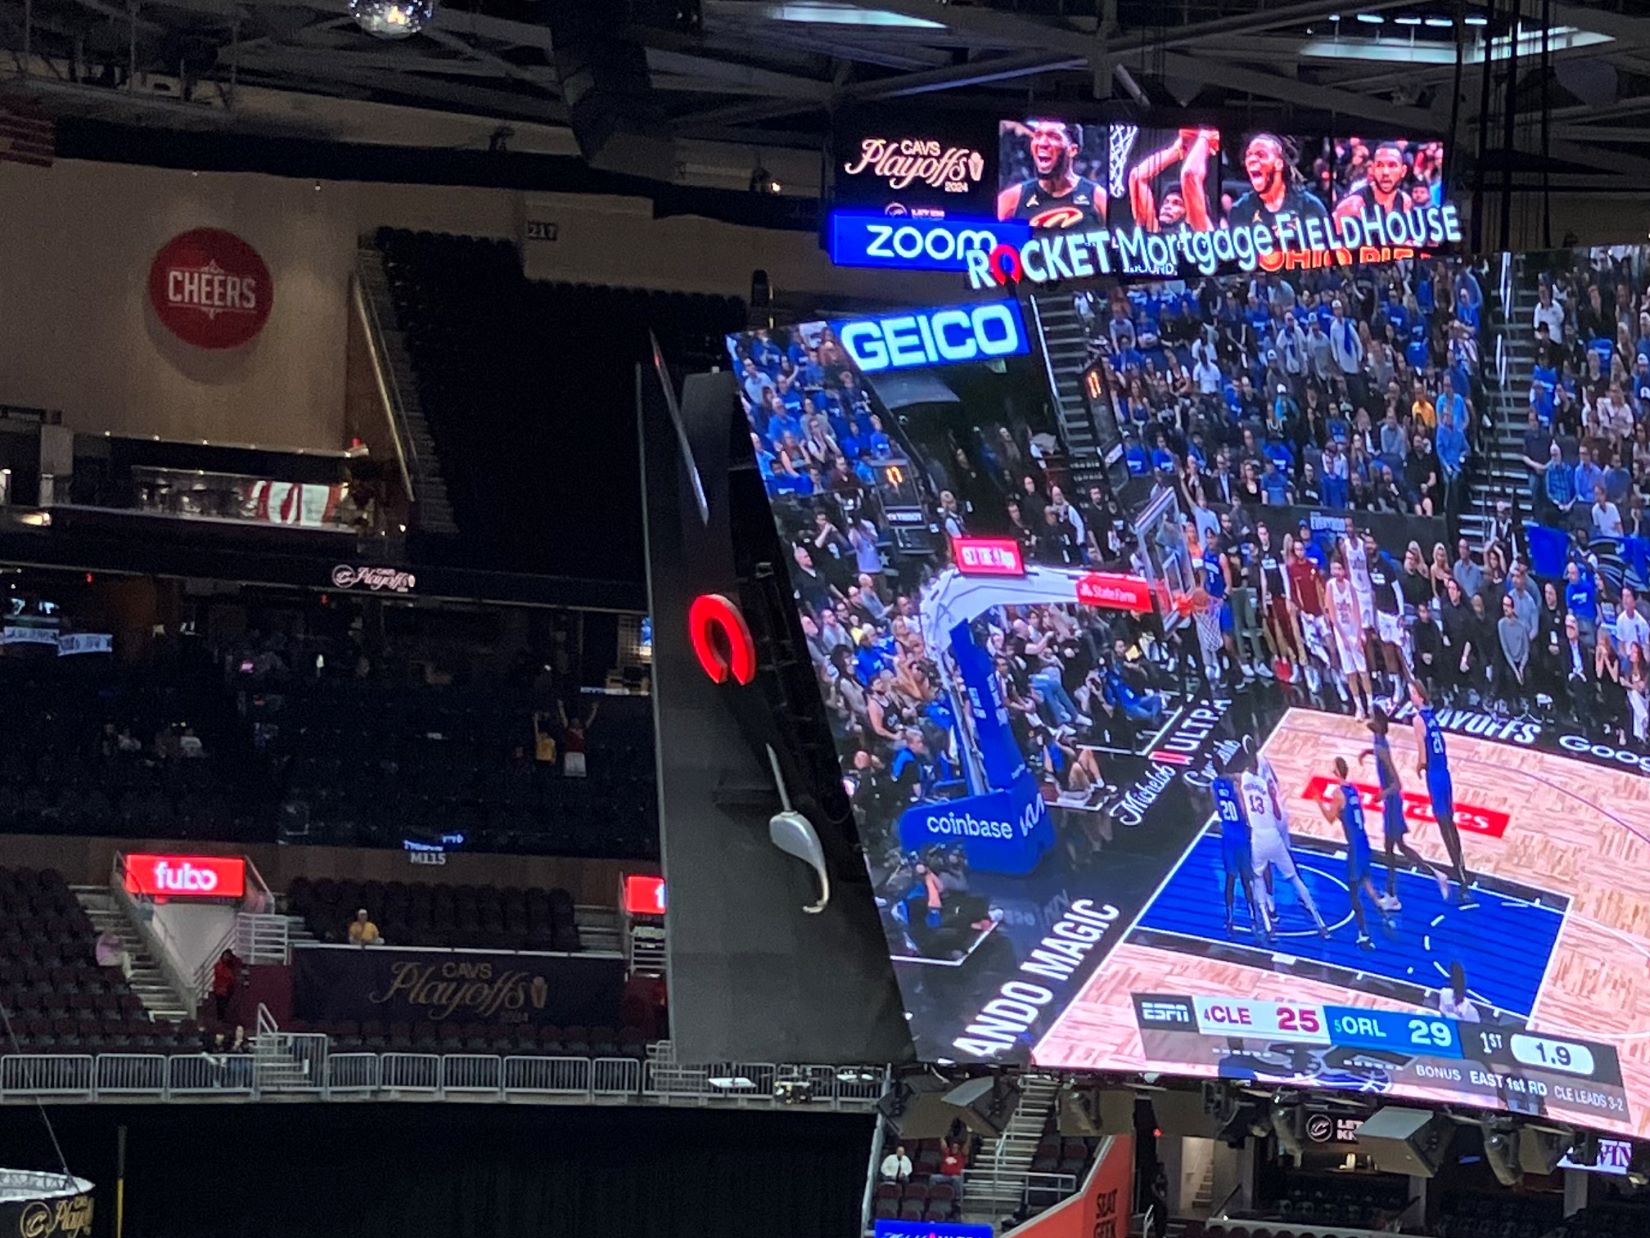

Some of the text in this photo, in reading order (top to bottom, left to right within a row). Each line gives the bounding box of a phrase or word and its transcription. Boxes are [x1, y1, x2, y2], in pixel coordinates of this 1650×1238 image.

[844, 138, 969, 189] Playoffs
[900, 140, 941, 156] CAVS
[944, 181, 968, 192] 2024
[966, 230, 1115, 290] ROCKET
[1116, 222, 1272, 275] Mortgage
[167, 271, 257, 308] CHEERS
[840, 304, 1019, 372] GEICO
[926, 812, 1014, 841] coinbase
[1222, 800, 1238, 822] 20
[410, 852, 446, 865] M115
[154, 864, 217, 891] fubo
[1020, 898, 1121, 982] MAGIC
[442, 962, 492, 980] CAVS
[369, 961, 528, 1021] Playoffs
[1140, 1001, 1572, 1067] ESPN CLE 25 ORL 29 1ST 1.9
[1416, 1064, 1461, 1081] BONUS
[1470, 1071, 1503, 1088] EAST
[1503, 1072, 1526, 1093] 1st
[1528, 1078, 1548, 1097] RD
[1554, 1085, 1577, 1102] CLE
[1577, 1088, 1608, 1109] LEADS
